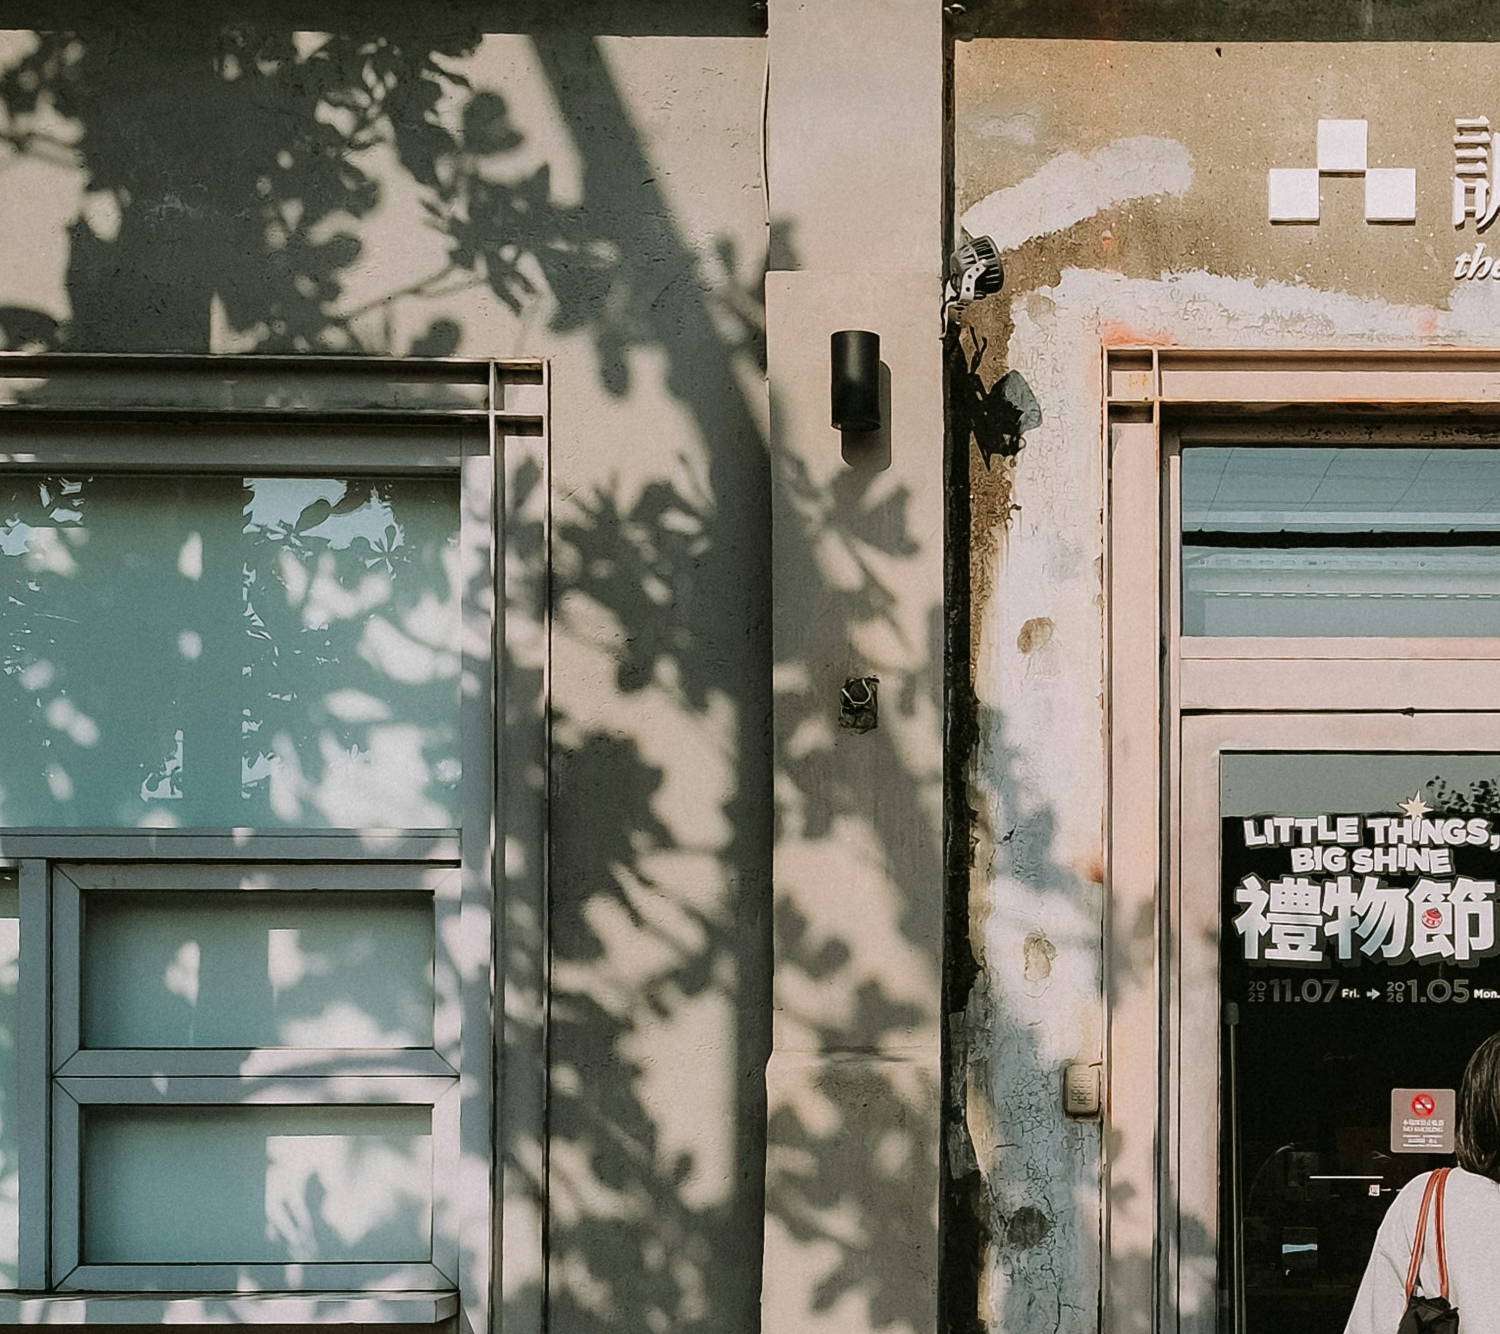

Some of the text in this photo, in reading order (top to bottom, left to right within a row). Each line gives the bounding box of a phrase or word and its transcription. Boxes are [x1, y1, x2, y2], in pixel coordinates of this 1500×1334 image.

[1243, 815, 1360, 847] LITTLE
[1290, 843, 1454, 874] BIG SHINE
[1233, 875, 1499, 962] 禮物節
[1269, 978, 1340, 1003] 11.07
[1341, 988, 1360, 1000] Fri.
[1406, 978, 1470, 1003] 1.05
[1473, 988, 1500, 1000] Mon.
